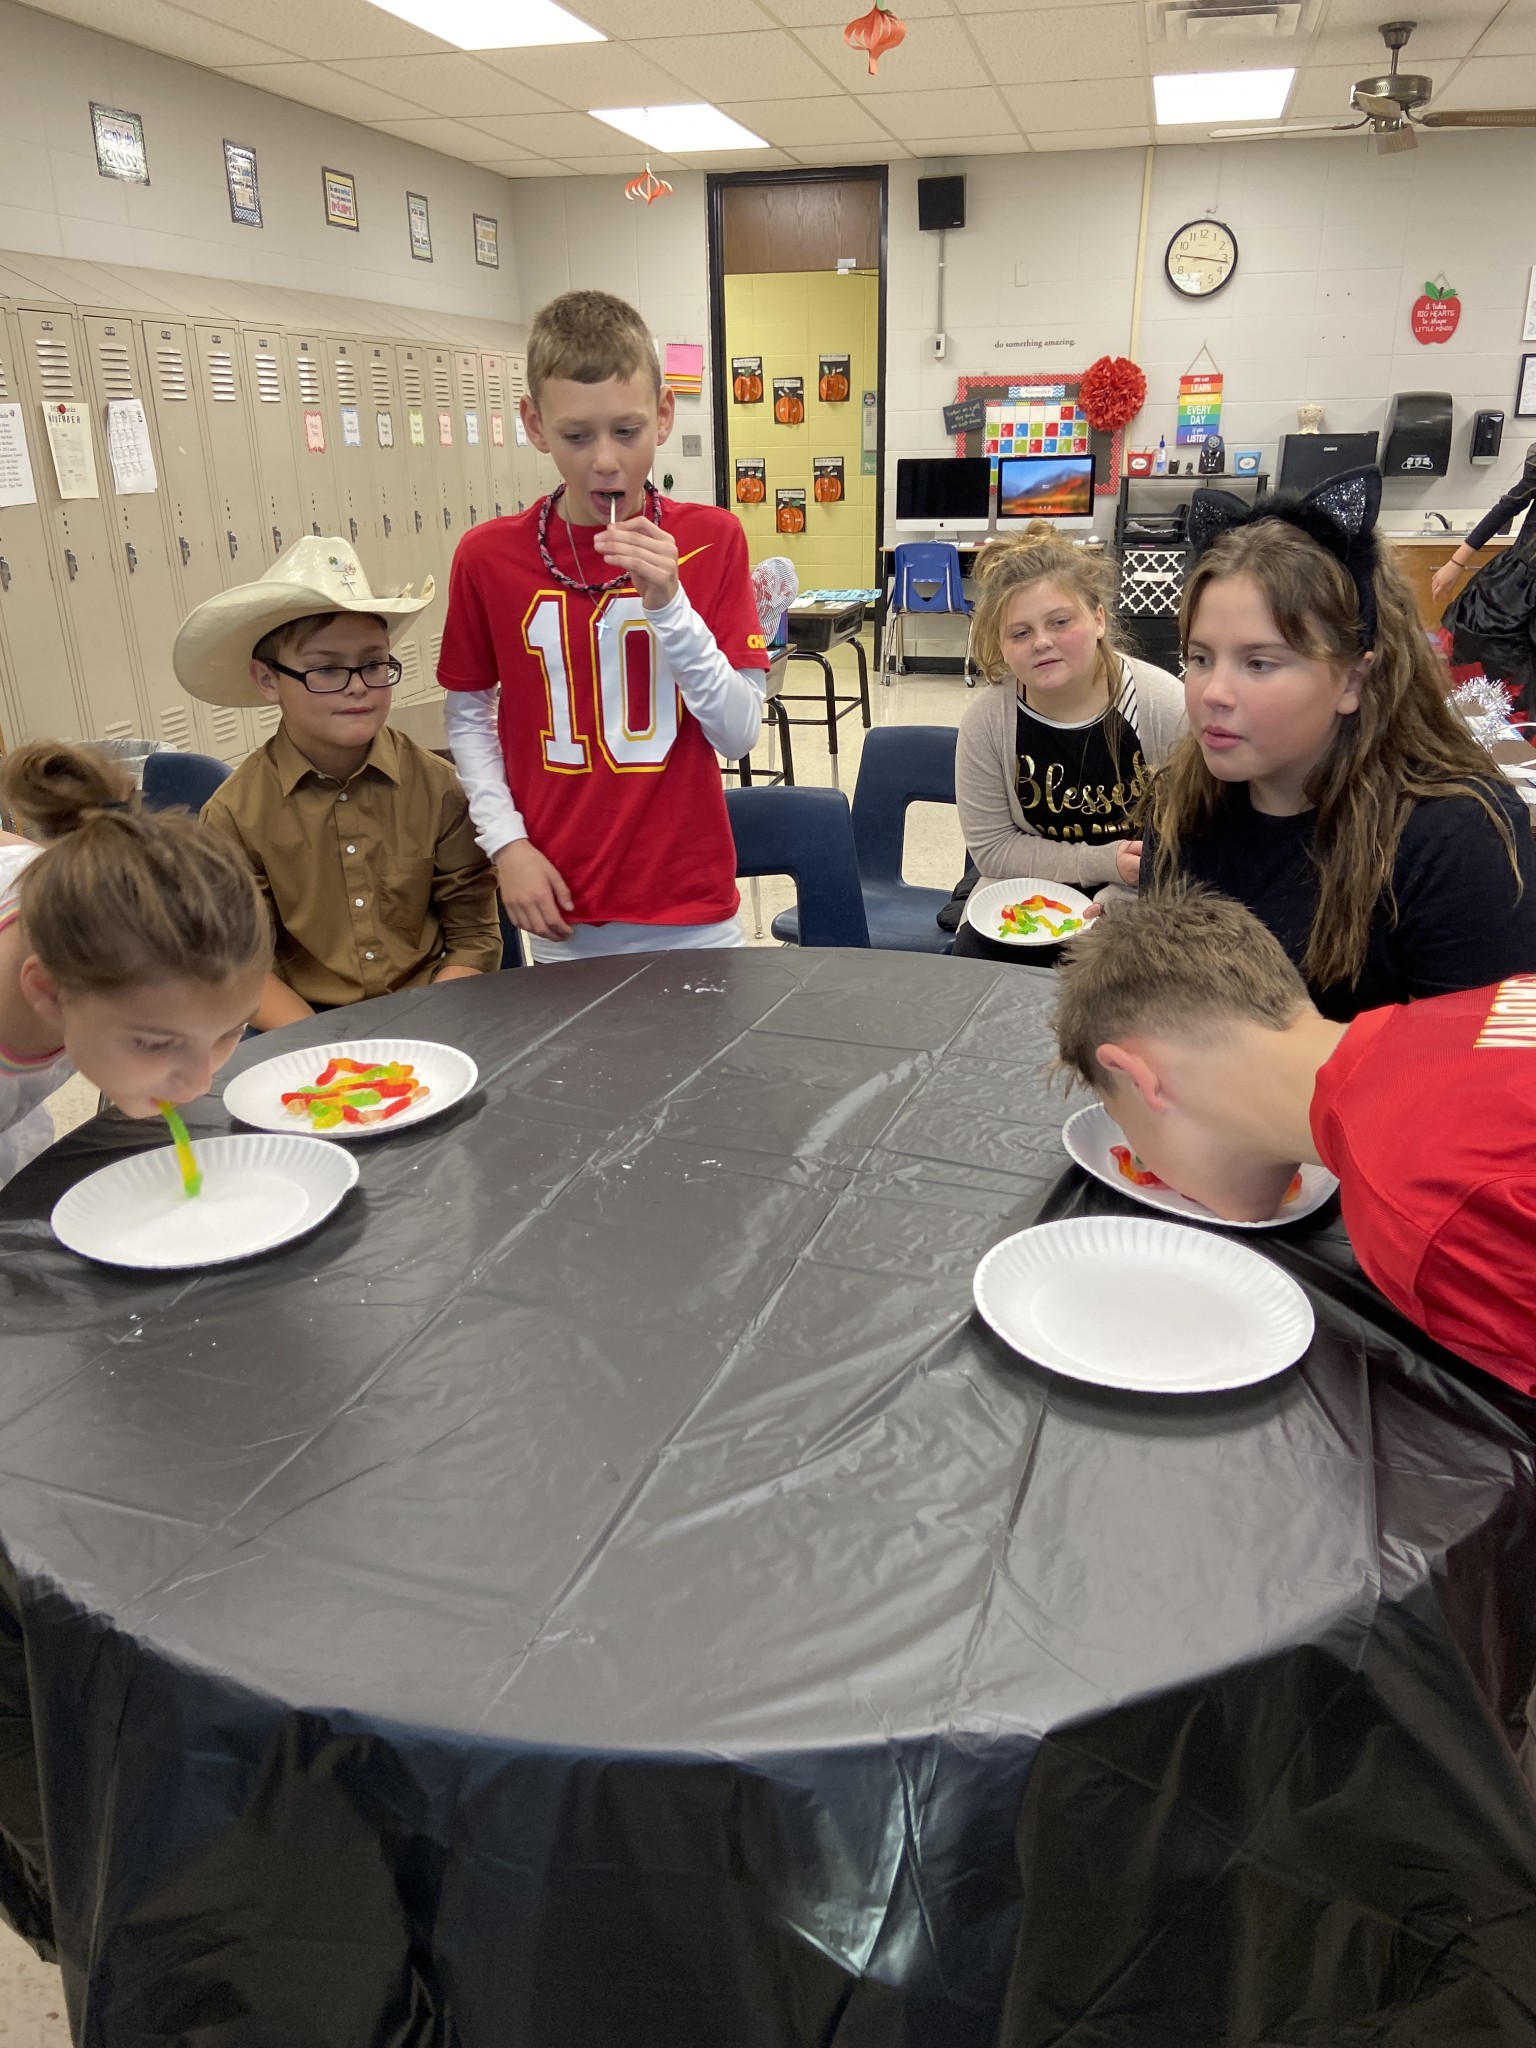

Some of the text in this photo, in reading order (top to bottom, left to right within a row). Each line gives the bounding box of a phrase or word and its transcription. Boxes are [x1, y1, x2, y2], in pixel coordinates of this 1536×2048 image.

[1190, 232, 1196, 241] 11
[1200, 229, 1209, 239] 12
[1214, 232, 1217, 241] 1
[1180, 241, 1189, 250] 10
[1219, 241, 1226, 250] 2
[1175, 253, 1181, 262] 9
[1222, 253, 1228, 262] 3
[1178, 266, 1184, 274] 8
[1217, 266, 1223, 275] 4
[1208, 274, 1214, 283] 5
[1432, 302, 1446, 310] takes
[1430, 317, 1446, 325] shape
[994, 338, 1076, 348] do something amazing.
[1191, 383, 1212, 392] LEARN
[1186, 405, 1212, 415] EVERY
[1190, 415, 1207, 425] DAY
[521, 588, 684, 775] 10
[1016, 750, 1147, 814] Blessed
